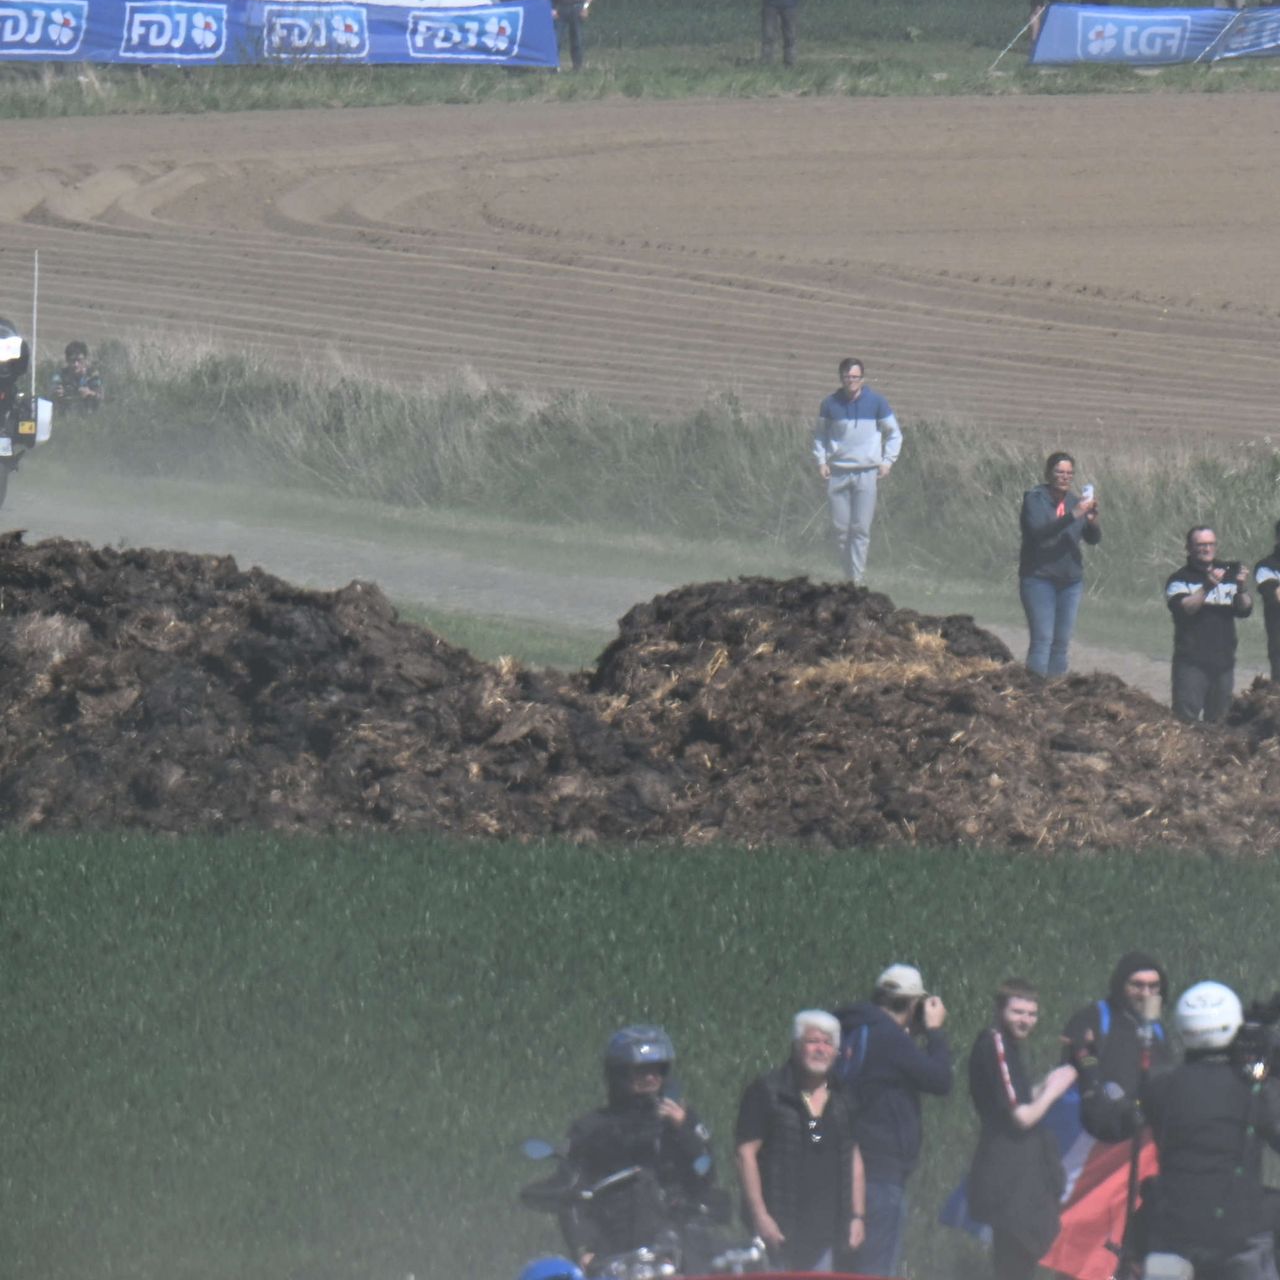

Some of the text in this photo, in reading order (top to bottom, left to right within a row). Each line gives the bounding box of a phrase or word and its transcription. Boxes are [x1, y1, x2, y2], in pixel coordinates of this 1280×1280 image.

[131, 12, 187, 48] FDJ
[272, 17, 326, 48] FDJ
[415, 20, 479, 50] FDJ
